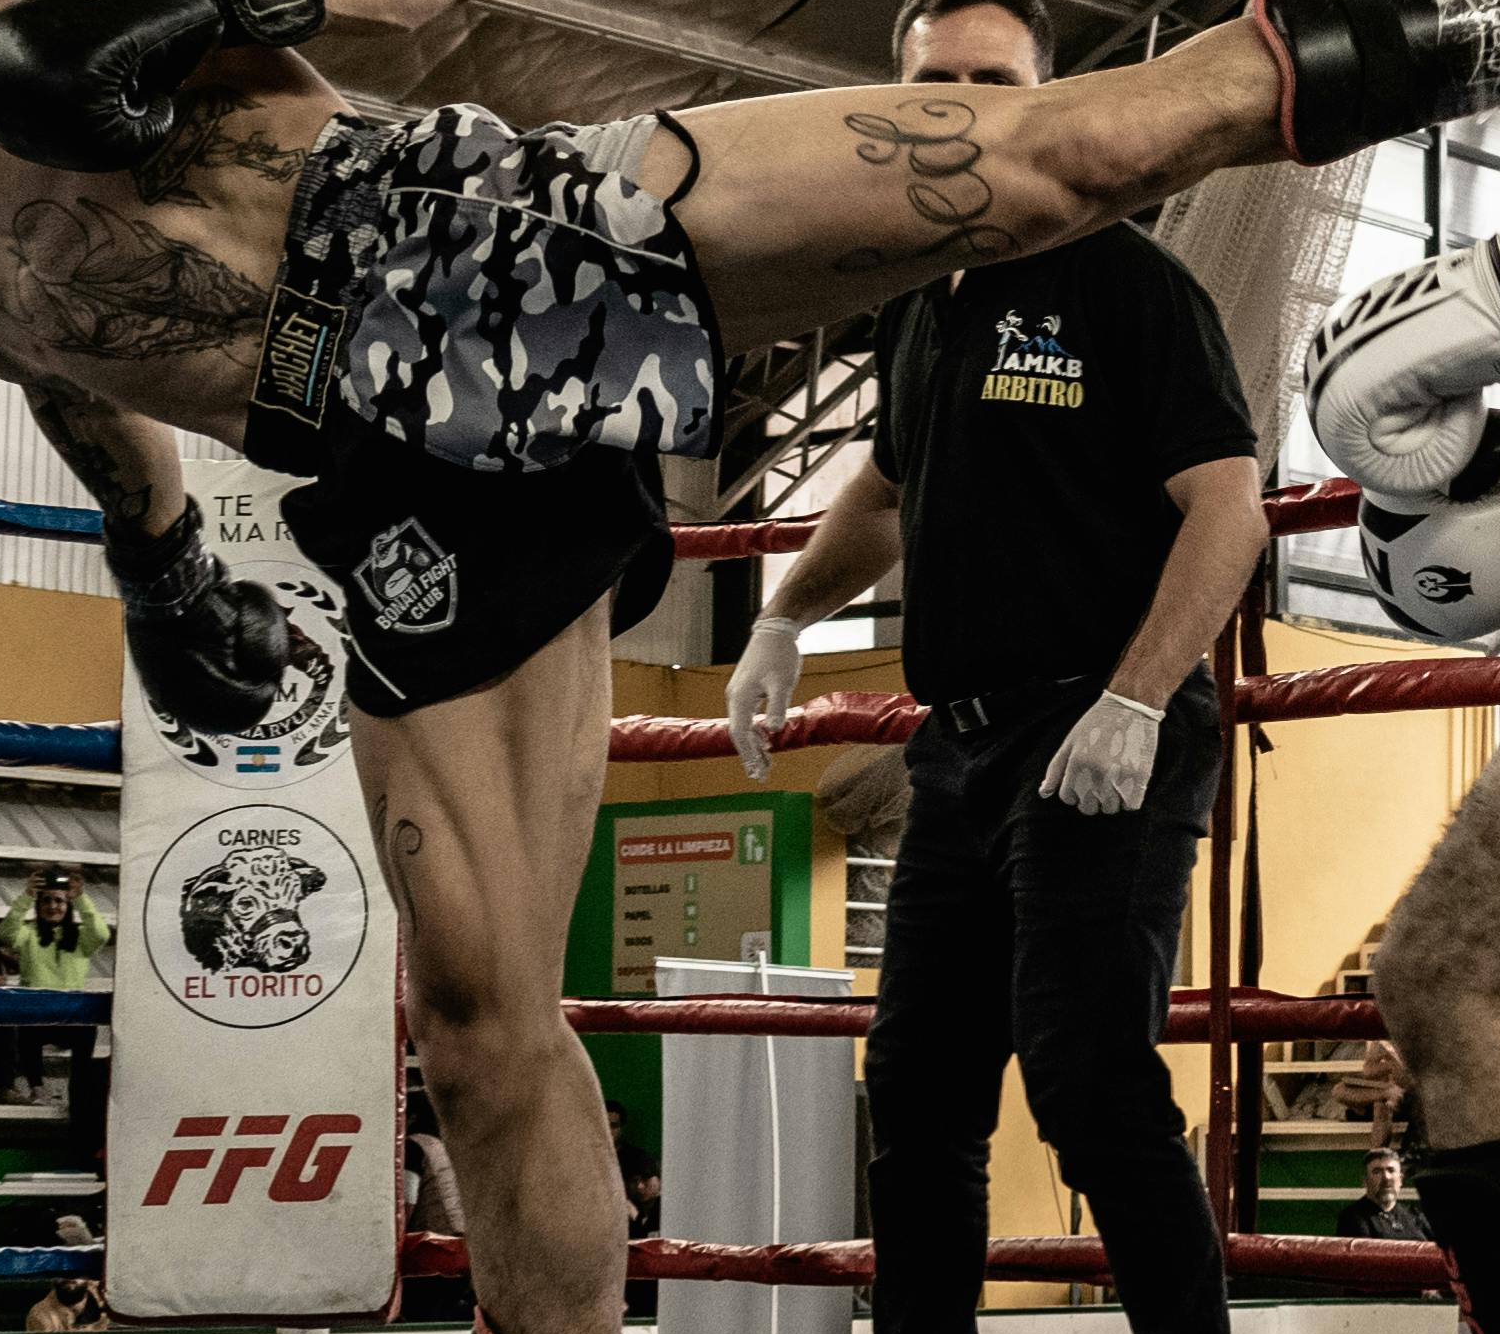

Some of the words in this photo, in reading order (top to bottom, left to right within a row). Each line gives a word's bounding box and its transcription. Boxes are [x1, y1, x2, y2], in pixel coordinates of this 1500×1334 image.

[270, 312, 321, 402] HACHET
[981, 374, 1084, 409] ARBITRO
[213, 494, 253, 517] TE
[375, 582, 423, 630] BONATI
[419, 553, 458, 590] FIGHT
[410, 586, 445, 620] CLUB
[217, 827, 302, 848] CARNES
[620, 843, 656, 857] CUIDE
[658, 844, 674, 855] LA
[676, 839, 731, 855] LIMPIEZA
[624, 883, 670, 896] BOTELLAS
[184, 976, 216, 999] EL
[222, 974, 324, 999] TORITO
[142, 1113, 363, 1207] FFG
